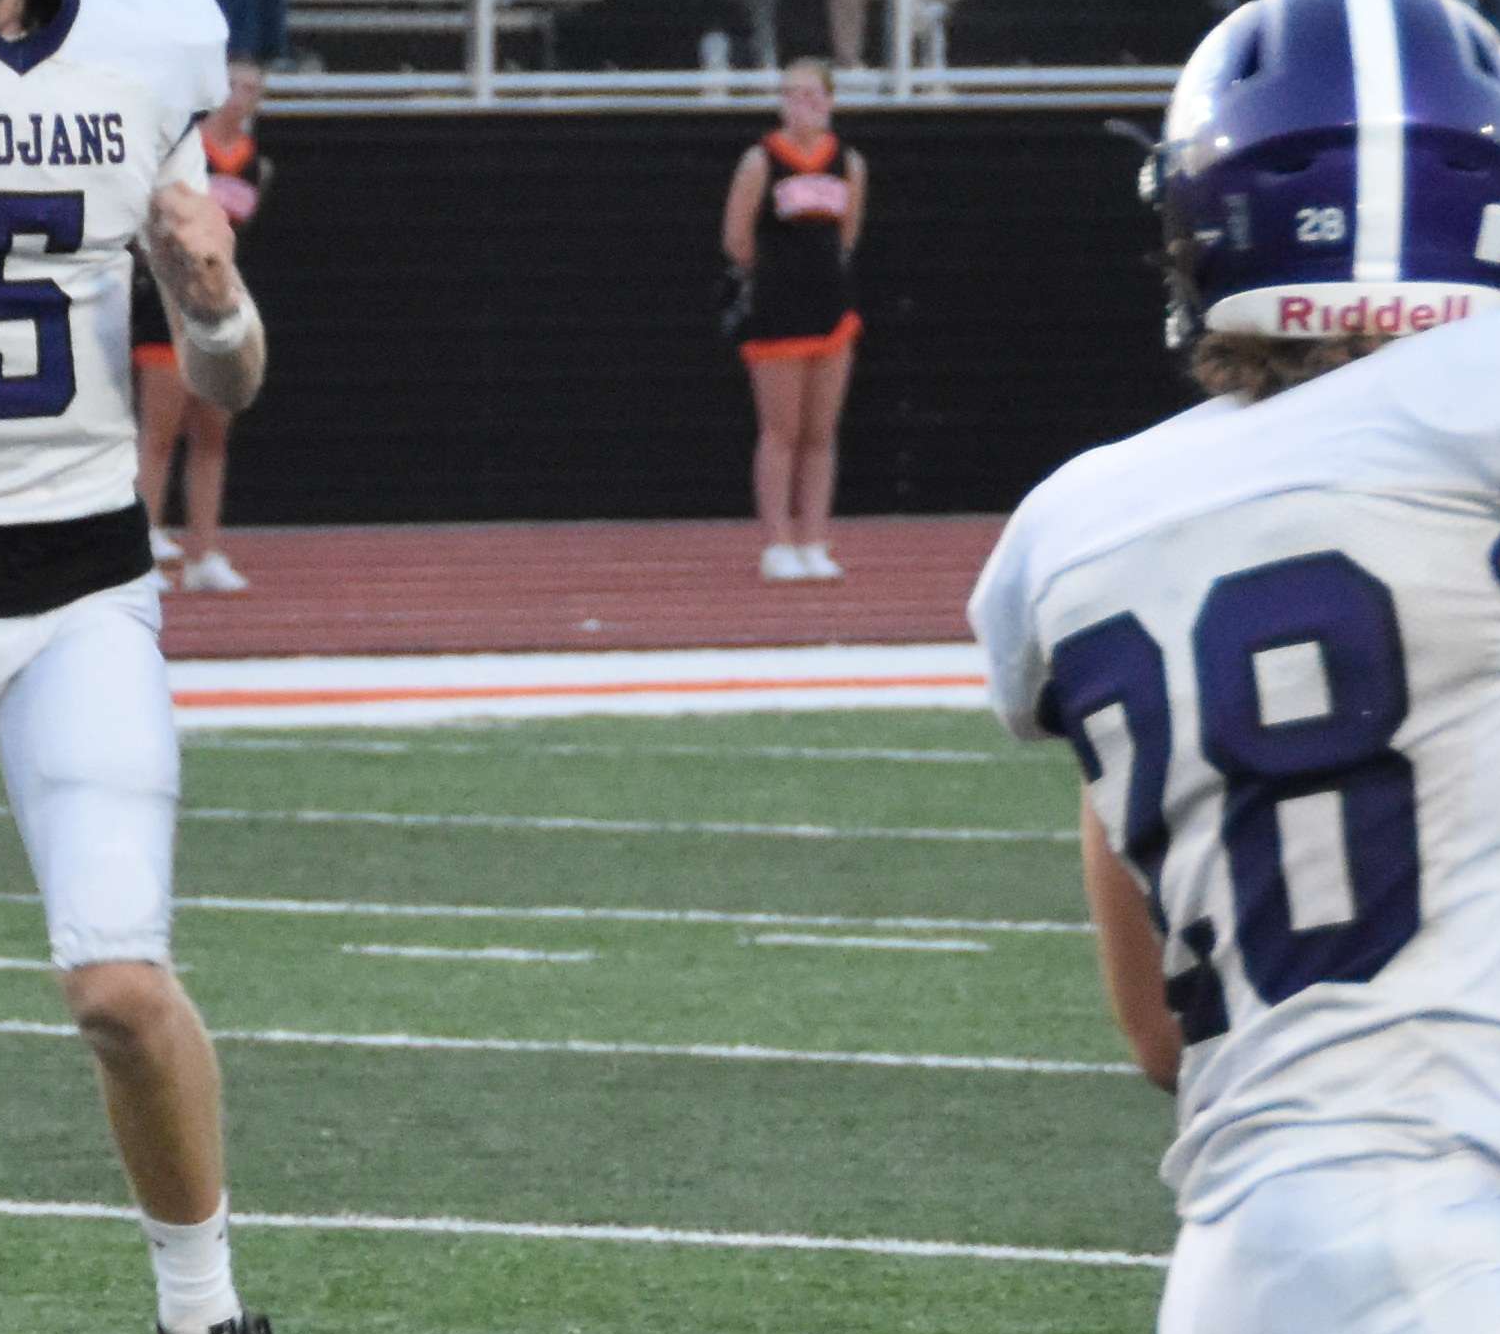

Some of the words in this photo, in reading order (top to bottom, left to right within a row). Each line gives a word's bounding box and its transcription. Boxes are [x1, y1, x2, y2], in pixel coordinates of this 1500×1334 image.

[1295, 206, 1347, 243] 28
[1277, 295, 1471, 333] Riddell
[1036, 549, 1421, 1045] 28
